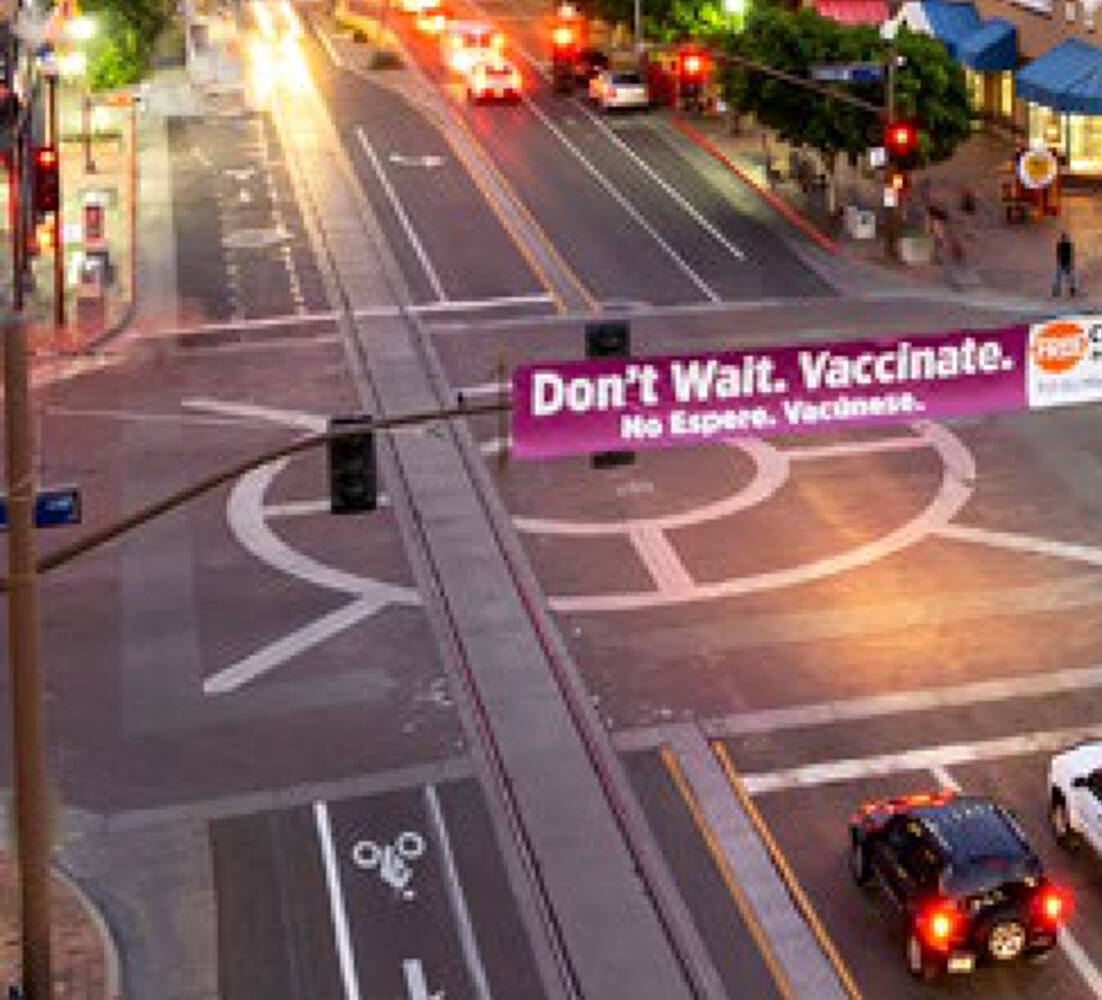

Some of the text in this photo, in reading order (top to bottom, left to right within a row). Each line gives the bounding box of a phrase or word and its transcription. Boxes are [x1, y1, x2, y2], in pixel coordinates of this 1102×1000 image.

[531, 363, 659, 417] Don't
[670, 355, 787, 403] Wait.
[799, 337, 1014, 389] Vaccinate.
[620, 414, 663, 440] No
[670, 408, 777, 437] Espere.
